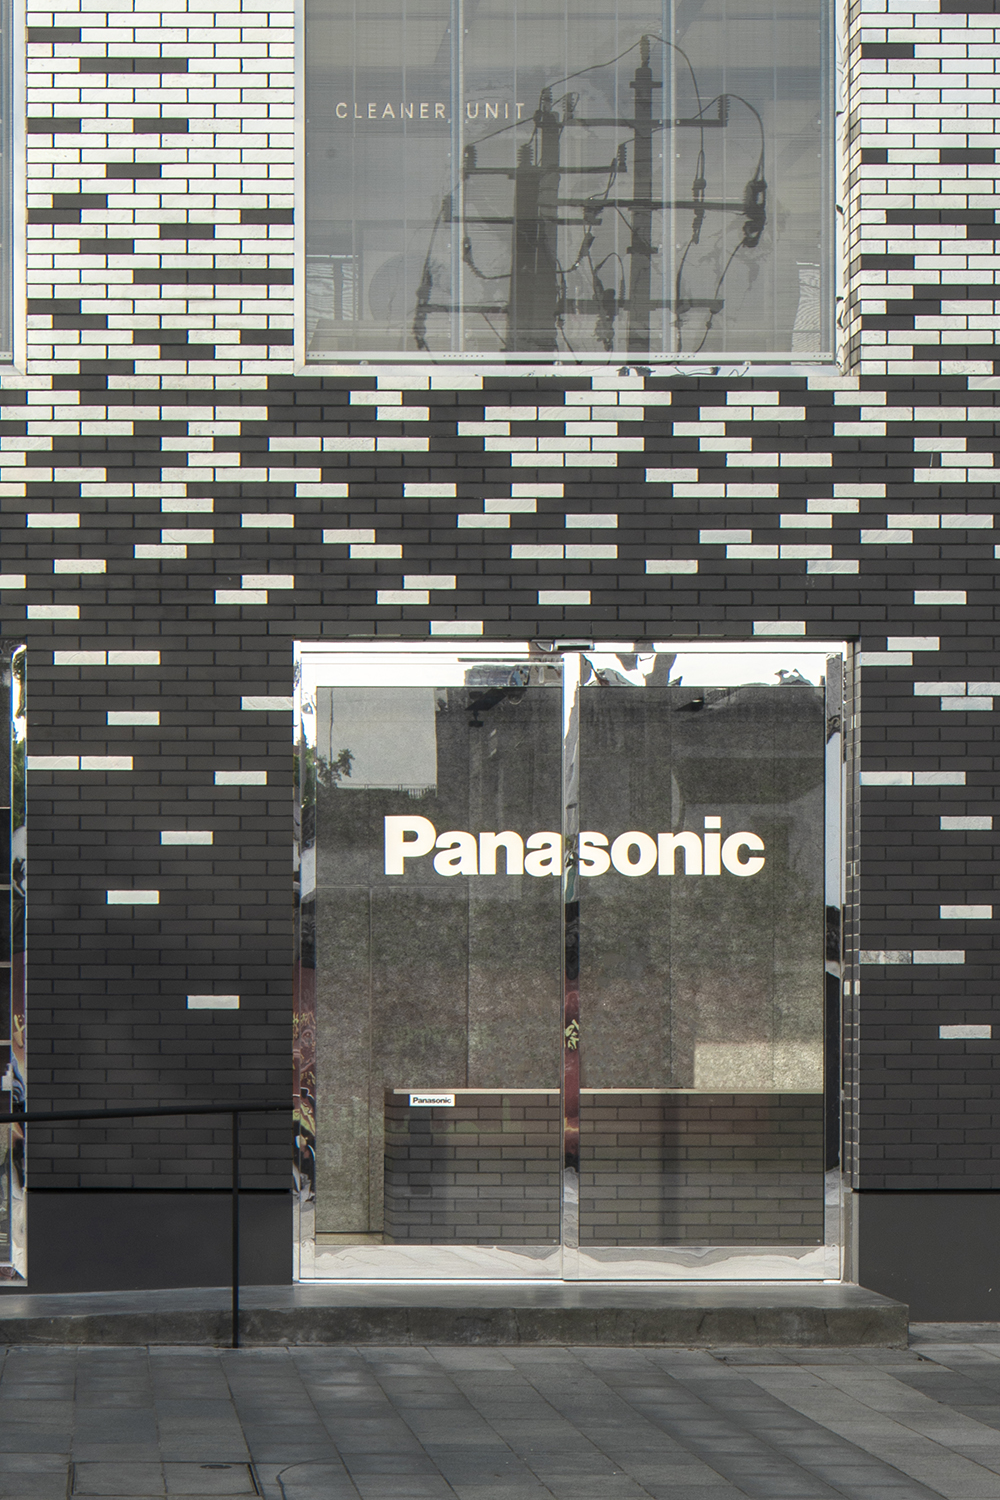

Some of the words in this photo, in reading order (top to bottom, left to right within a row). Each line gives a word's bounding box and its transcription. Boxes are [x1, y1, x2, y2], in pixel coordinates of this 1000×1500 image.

[335, 102, 446, 119] CLEANER
[466, 102, 525, 119] UNIT
[384, 815, 765, 877] Panasonic
[412, 1096, 452, 1104] Panasonic
